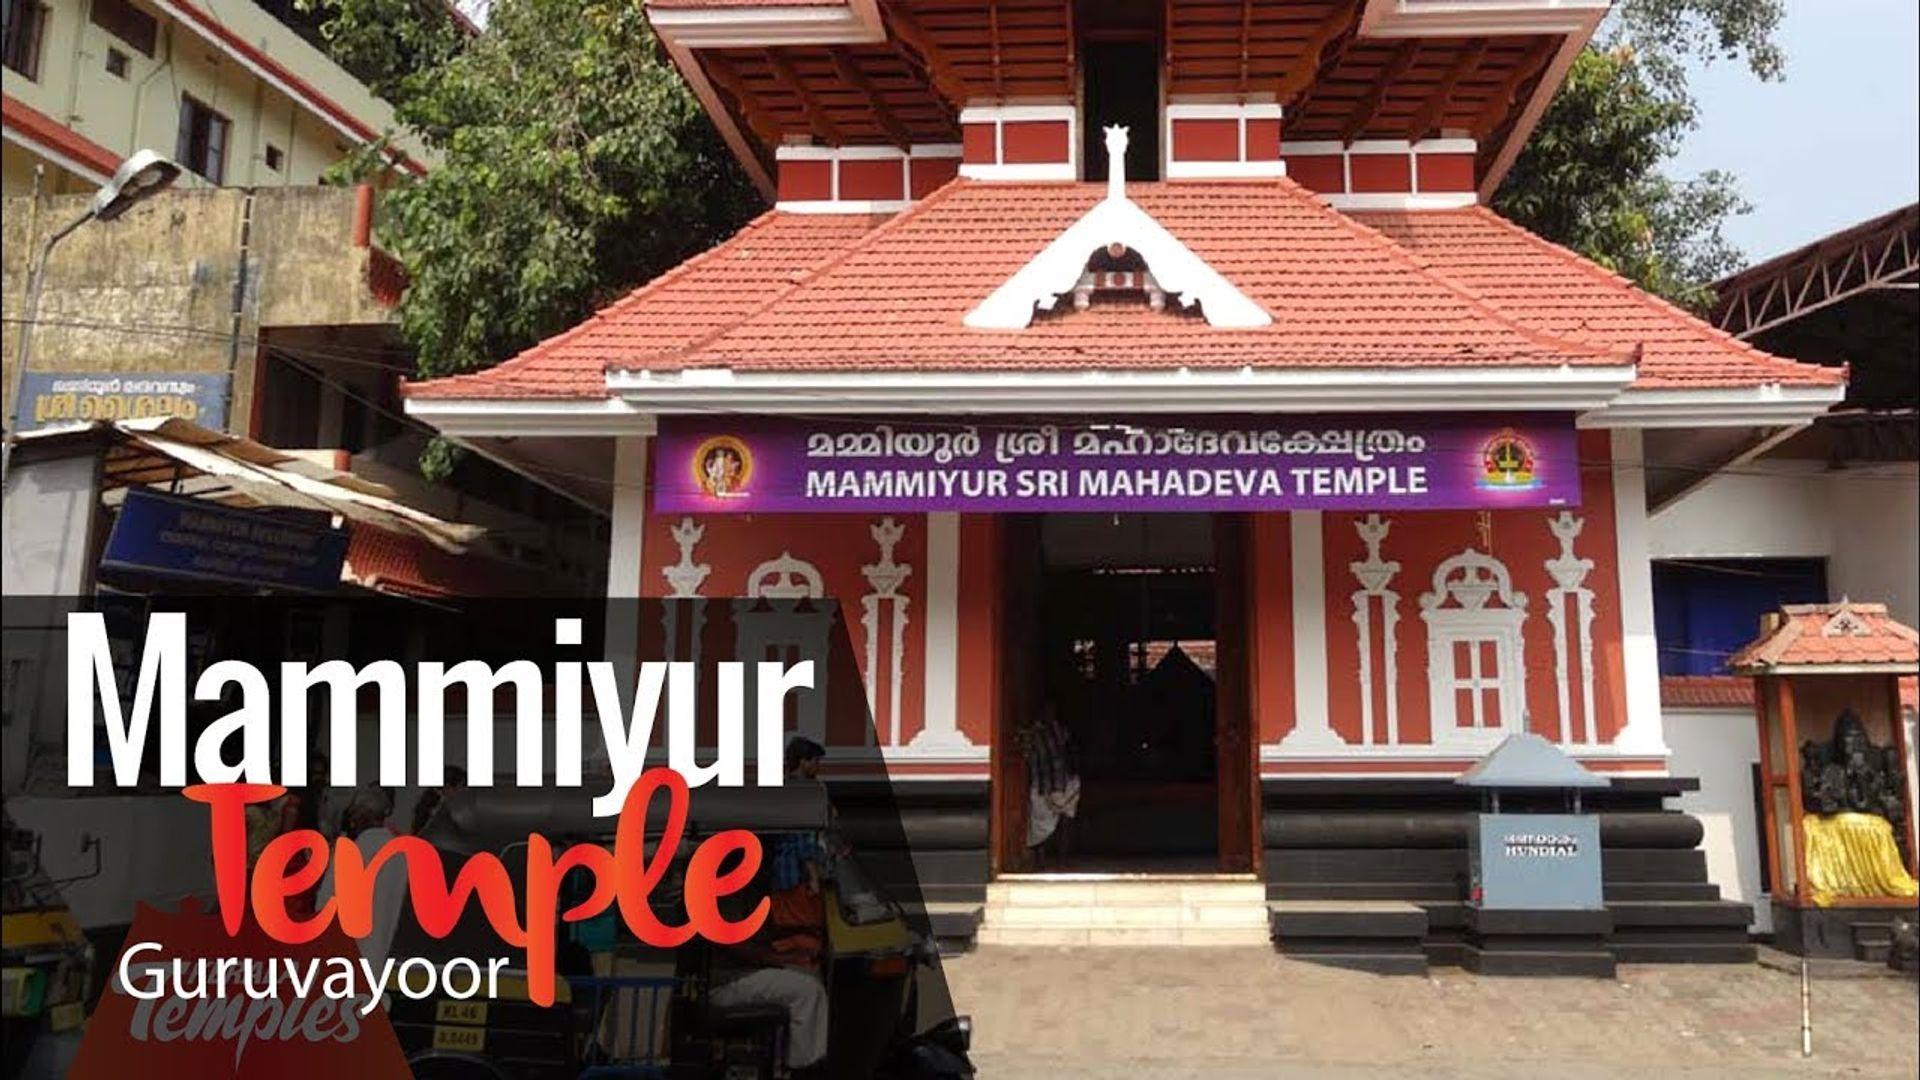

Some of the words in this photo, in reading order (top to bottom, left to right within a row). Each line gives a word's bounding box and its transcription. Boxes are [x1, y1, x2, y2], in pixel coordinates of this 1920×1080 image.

[807, 425, 981, 463] മമ്മിയൂർ
[995, 425, 1059, 463] ശ്രീ
[1073, 428, 1426, 461] മഹാദേവക്ഷേത്രം
[805, 469, 1008, 498] MAMMIYUR
[1015, 469, 1069, 497] SRI
[1078, 468, 1284, 497] MAHADEVA
[1291, 466, 1429, 495] TEMPLE
